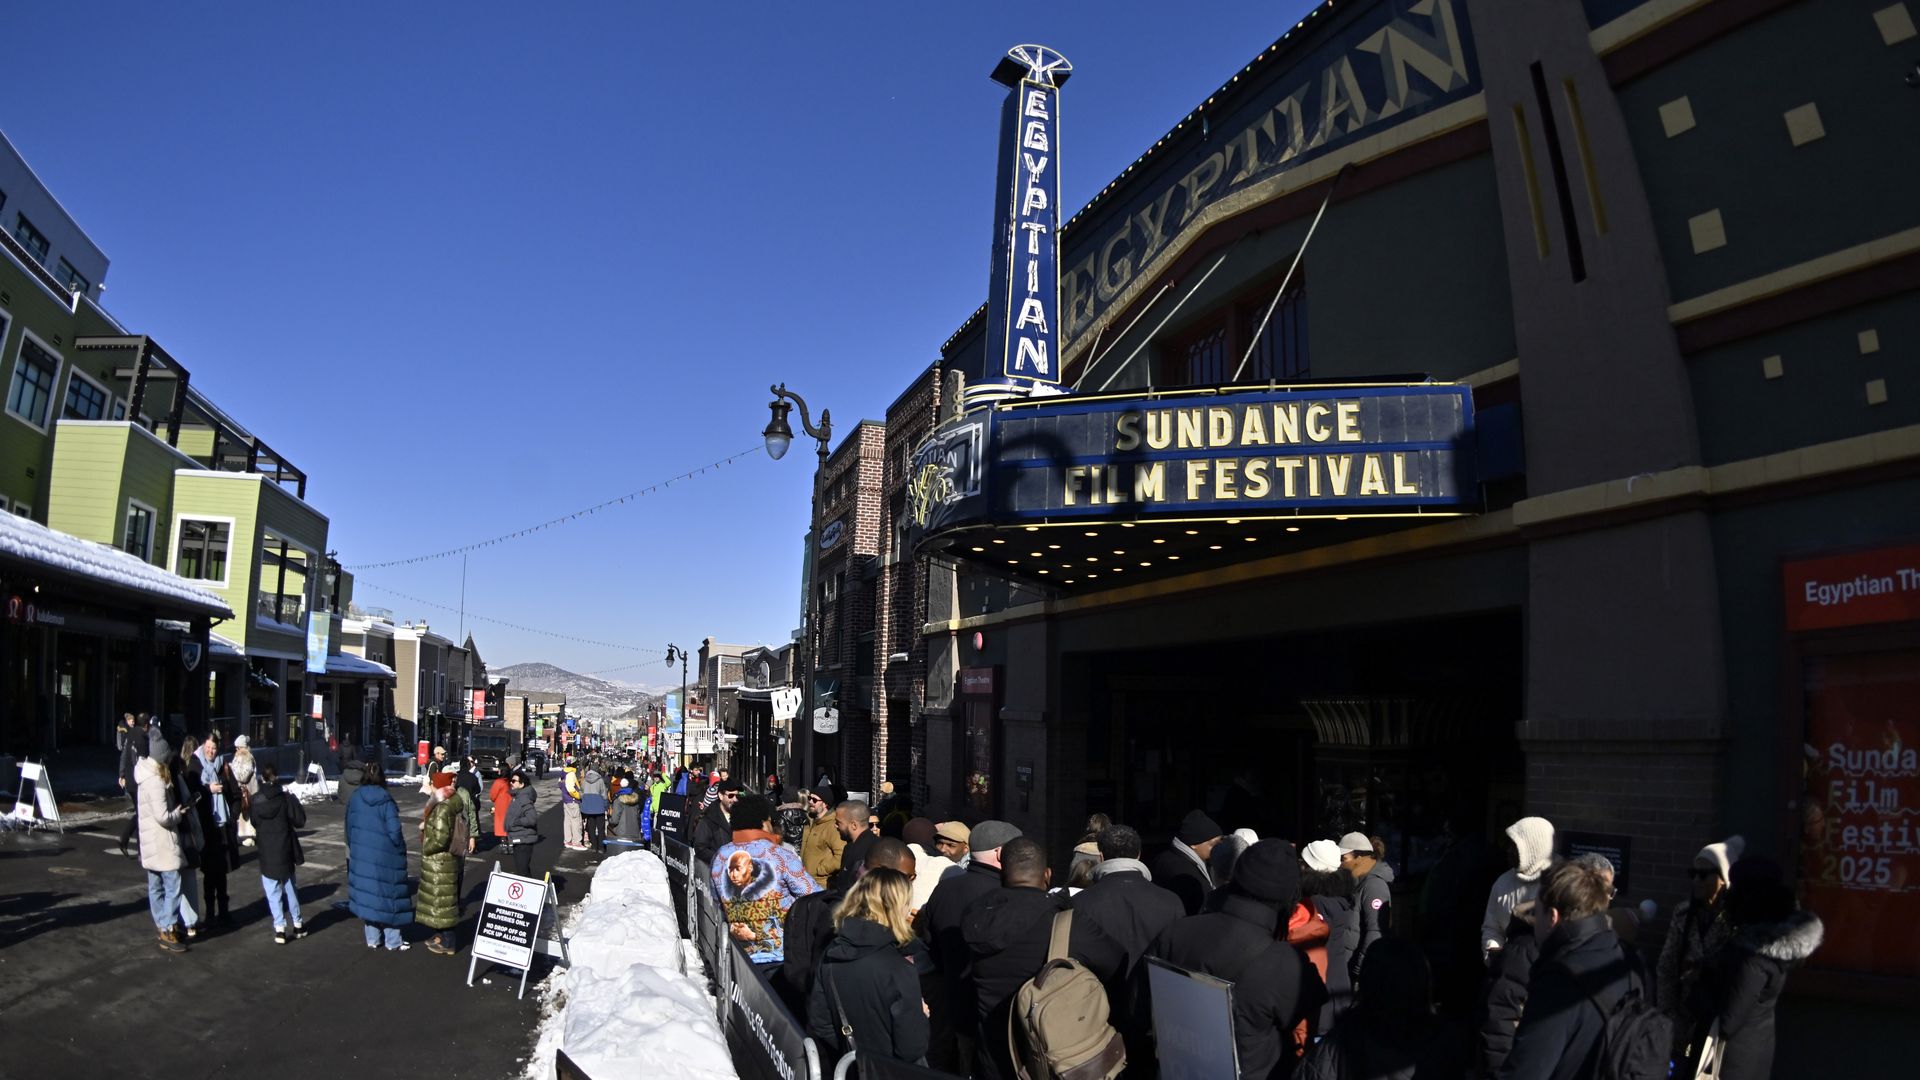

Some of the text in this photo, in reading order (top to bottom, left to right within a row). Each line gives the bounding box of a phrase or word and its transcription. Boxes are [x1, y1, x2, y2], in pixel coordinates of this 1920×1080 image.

[1060, 0, 1469, 336] EGYPTIAN
[1014, 88, 1049, 375] EGYPTIAN
[1115, 402, 1361, 452] SUNDANCE
[1064, 453, 1419, 506] FILM FESTIVAL
[1805, 574, 1894, 606] Egyptian
[1828, 742, 1918, 770] Sunda
[1827, 780, 1899, 808] Film
[661, 808, 680, 818] CAUTION
[1822, 854, 1892, 885] 2025
[488, 912, 515, 924] DELIVERIES
[496, 908, 524, 919] PERMITTED
[506, 900, 527, 910] PARKING
[503, 932, 527, 944] ALLOWED
